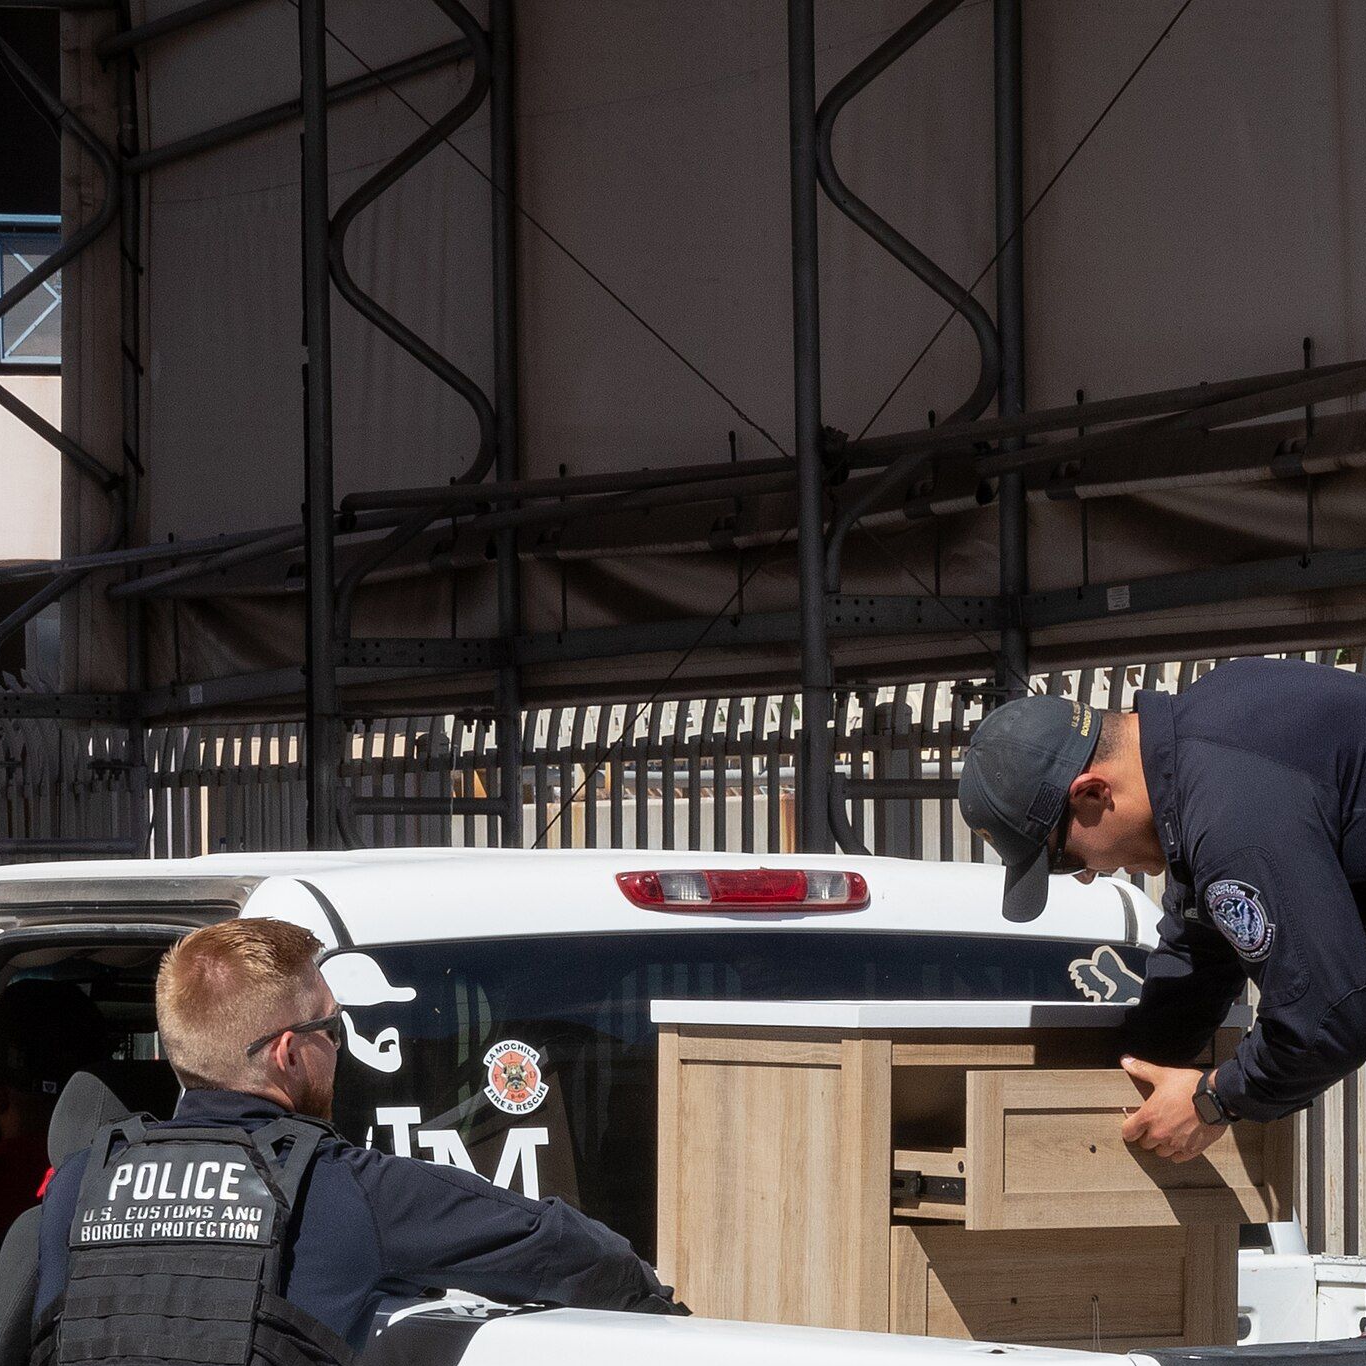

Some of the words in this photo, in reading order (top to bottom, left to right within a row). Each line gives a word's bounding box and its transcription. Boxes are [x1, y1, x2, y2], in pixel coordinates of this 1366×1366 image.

[487, 1054, 495, 1064] LA
[495, 1044, 537, 1060] MOCHILA
[487, 1089, 506, 1108] FIRE
[517, 1086, 546, 1112] RESCUE
[108, 1160, 247, 1200] POLICE
[83, 1206, 116, 1224] U.S.
[125, 1204, 215, 1220] CUSTOMS
[221, 1206, 263, 1222] AND
[81, 1222, 144, 1242] BORDER
[151, 1221, 259, 1241] PROTECTION
